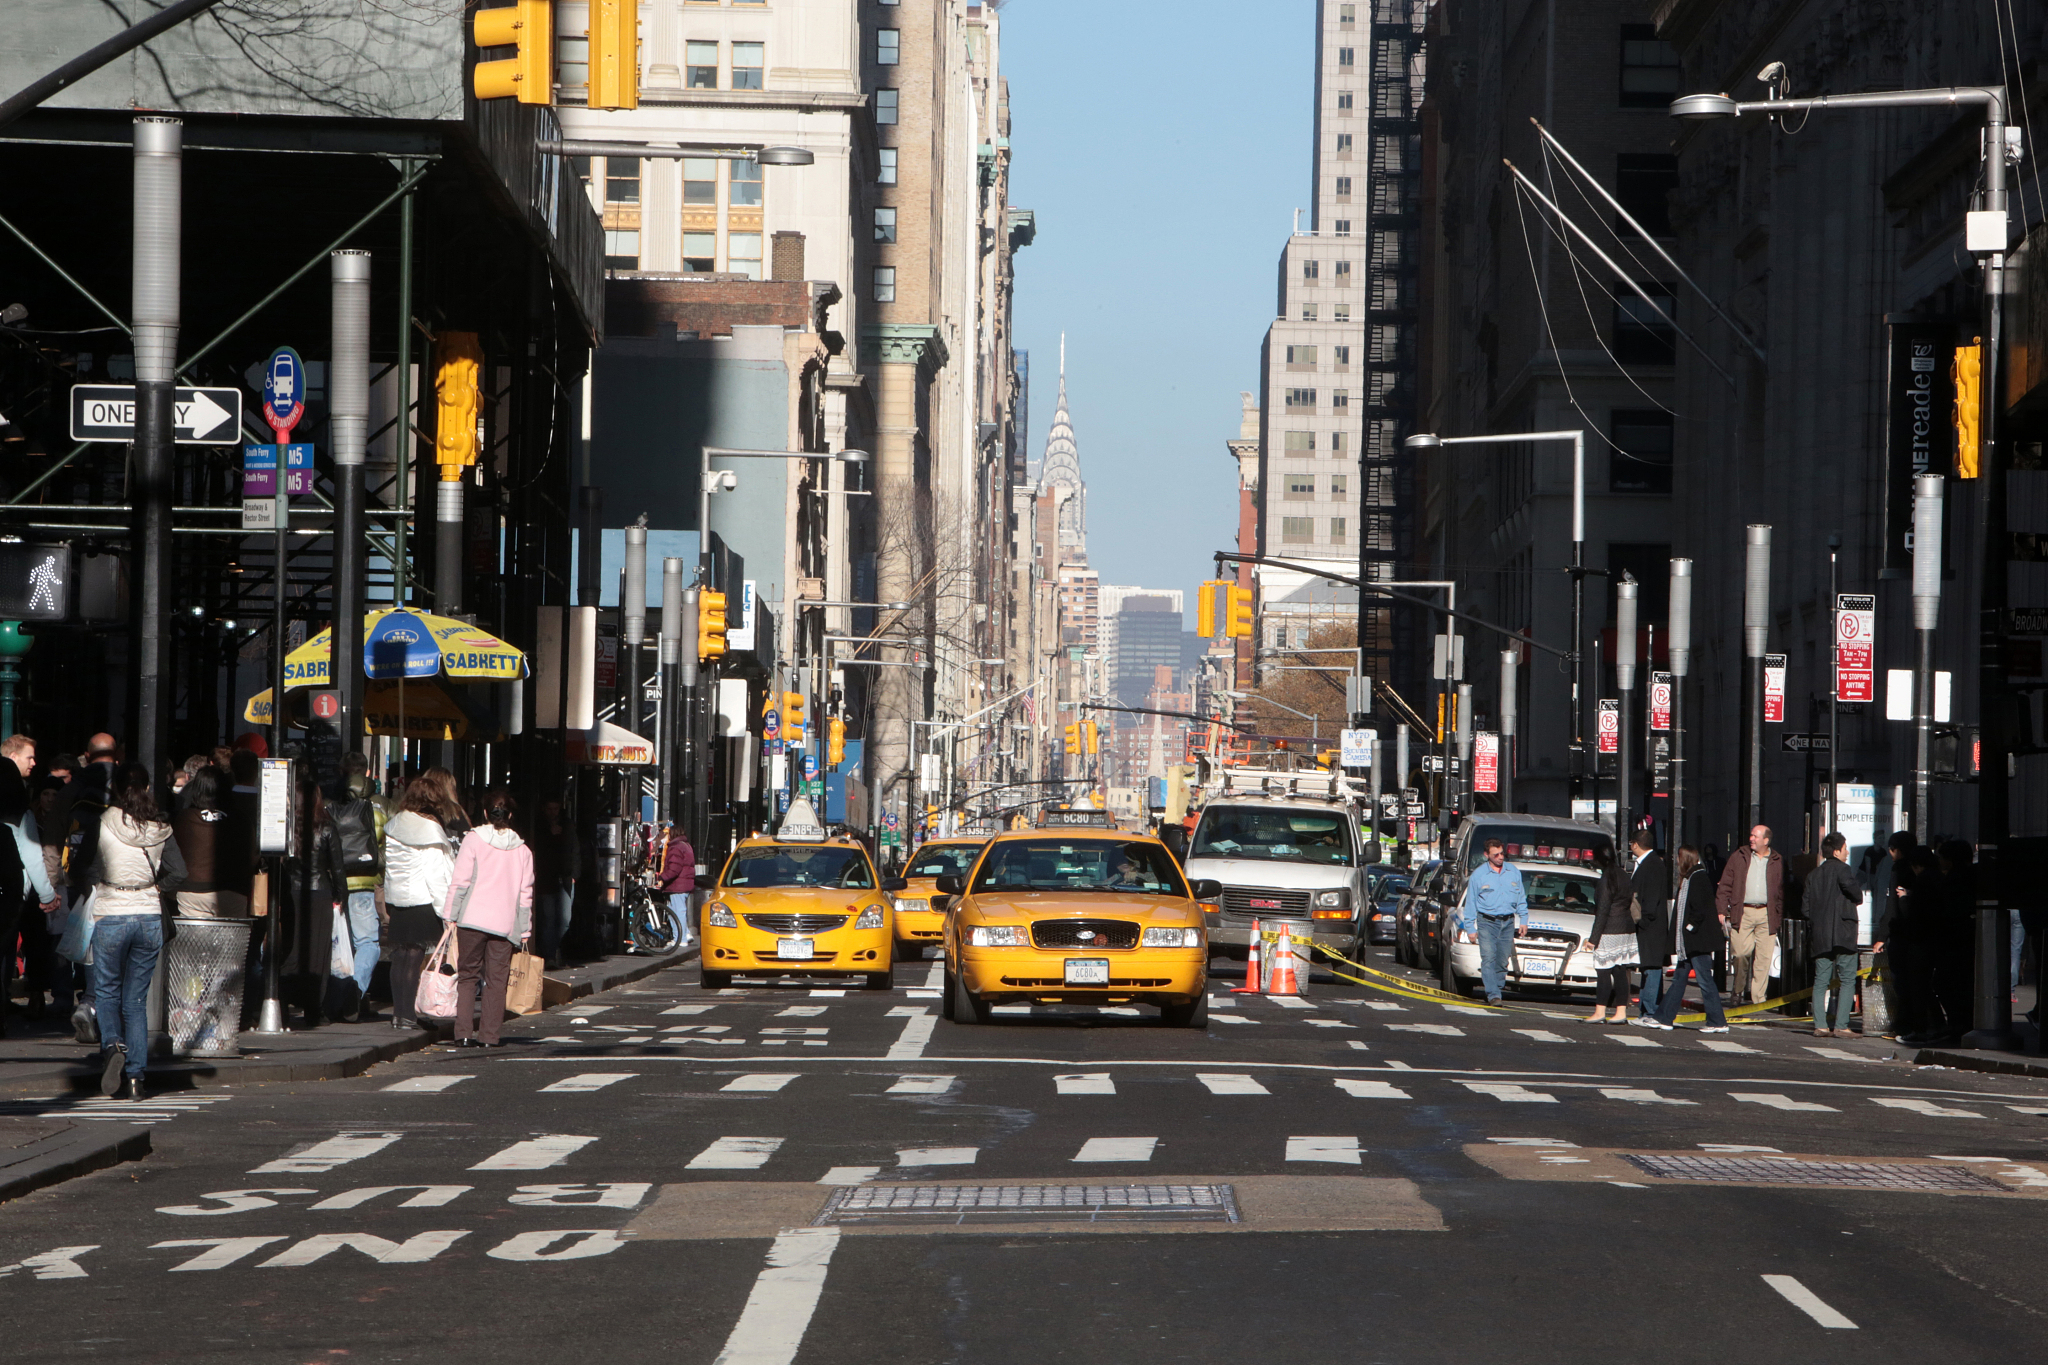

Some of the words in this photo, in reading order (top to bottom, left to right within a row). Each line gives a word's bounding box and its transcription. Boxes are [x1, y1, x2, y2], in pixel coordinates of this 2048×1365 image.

[92, 403, 135, 423] ONE
[265, 405, 274, 420] NO
[272, 405, 299, 428] STANDING
[245, 447, 258, 457] South
[258, 448, 269, 459] Ferry
[289, 446, 303, 465] M5
[245, 472, 258, 481] South
[258, 473, 268, 483] Ferry
[287, 472, 302, 491] M5
[244, 502, 263, 512] Broadway
[264, 503, 268, 511] &
[244, 513, 259, 522] Rector
[259, 513, 270, 522] Street
[435, 626, 477, 640] SABRETT
[408, 660, 424, 668] ROLL
[446, 653, 519, 671] SABRETT
[1790, 739, 1807, 747] ONE
[591, 745, 616, 760] NUTS
[623, 746, 647, 762] NUTS
[263, 761, 275, 769] Trip
[1850, 789, 1882, 798] TITAN
[1063, 812, 1089, 823] 6C80
[789, 824, 812, 835] 3N89
[966, 827, 984, 835] 9J58
[1250, 900, 1282, 908] GMC
[1526, 962, 1547, 972] 2286
[154, 1182, 654, 1216] BUS
